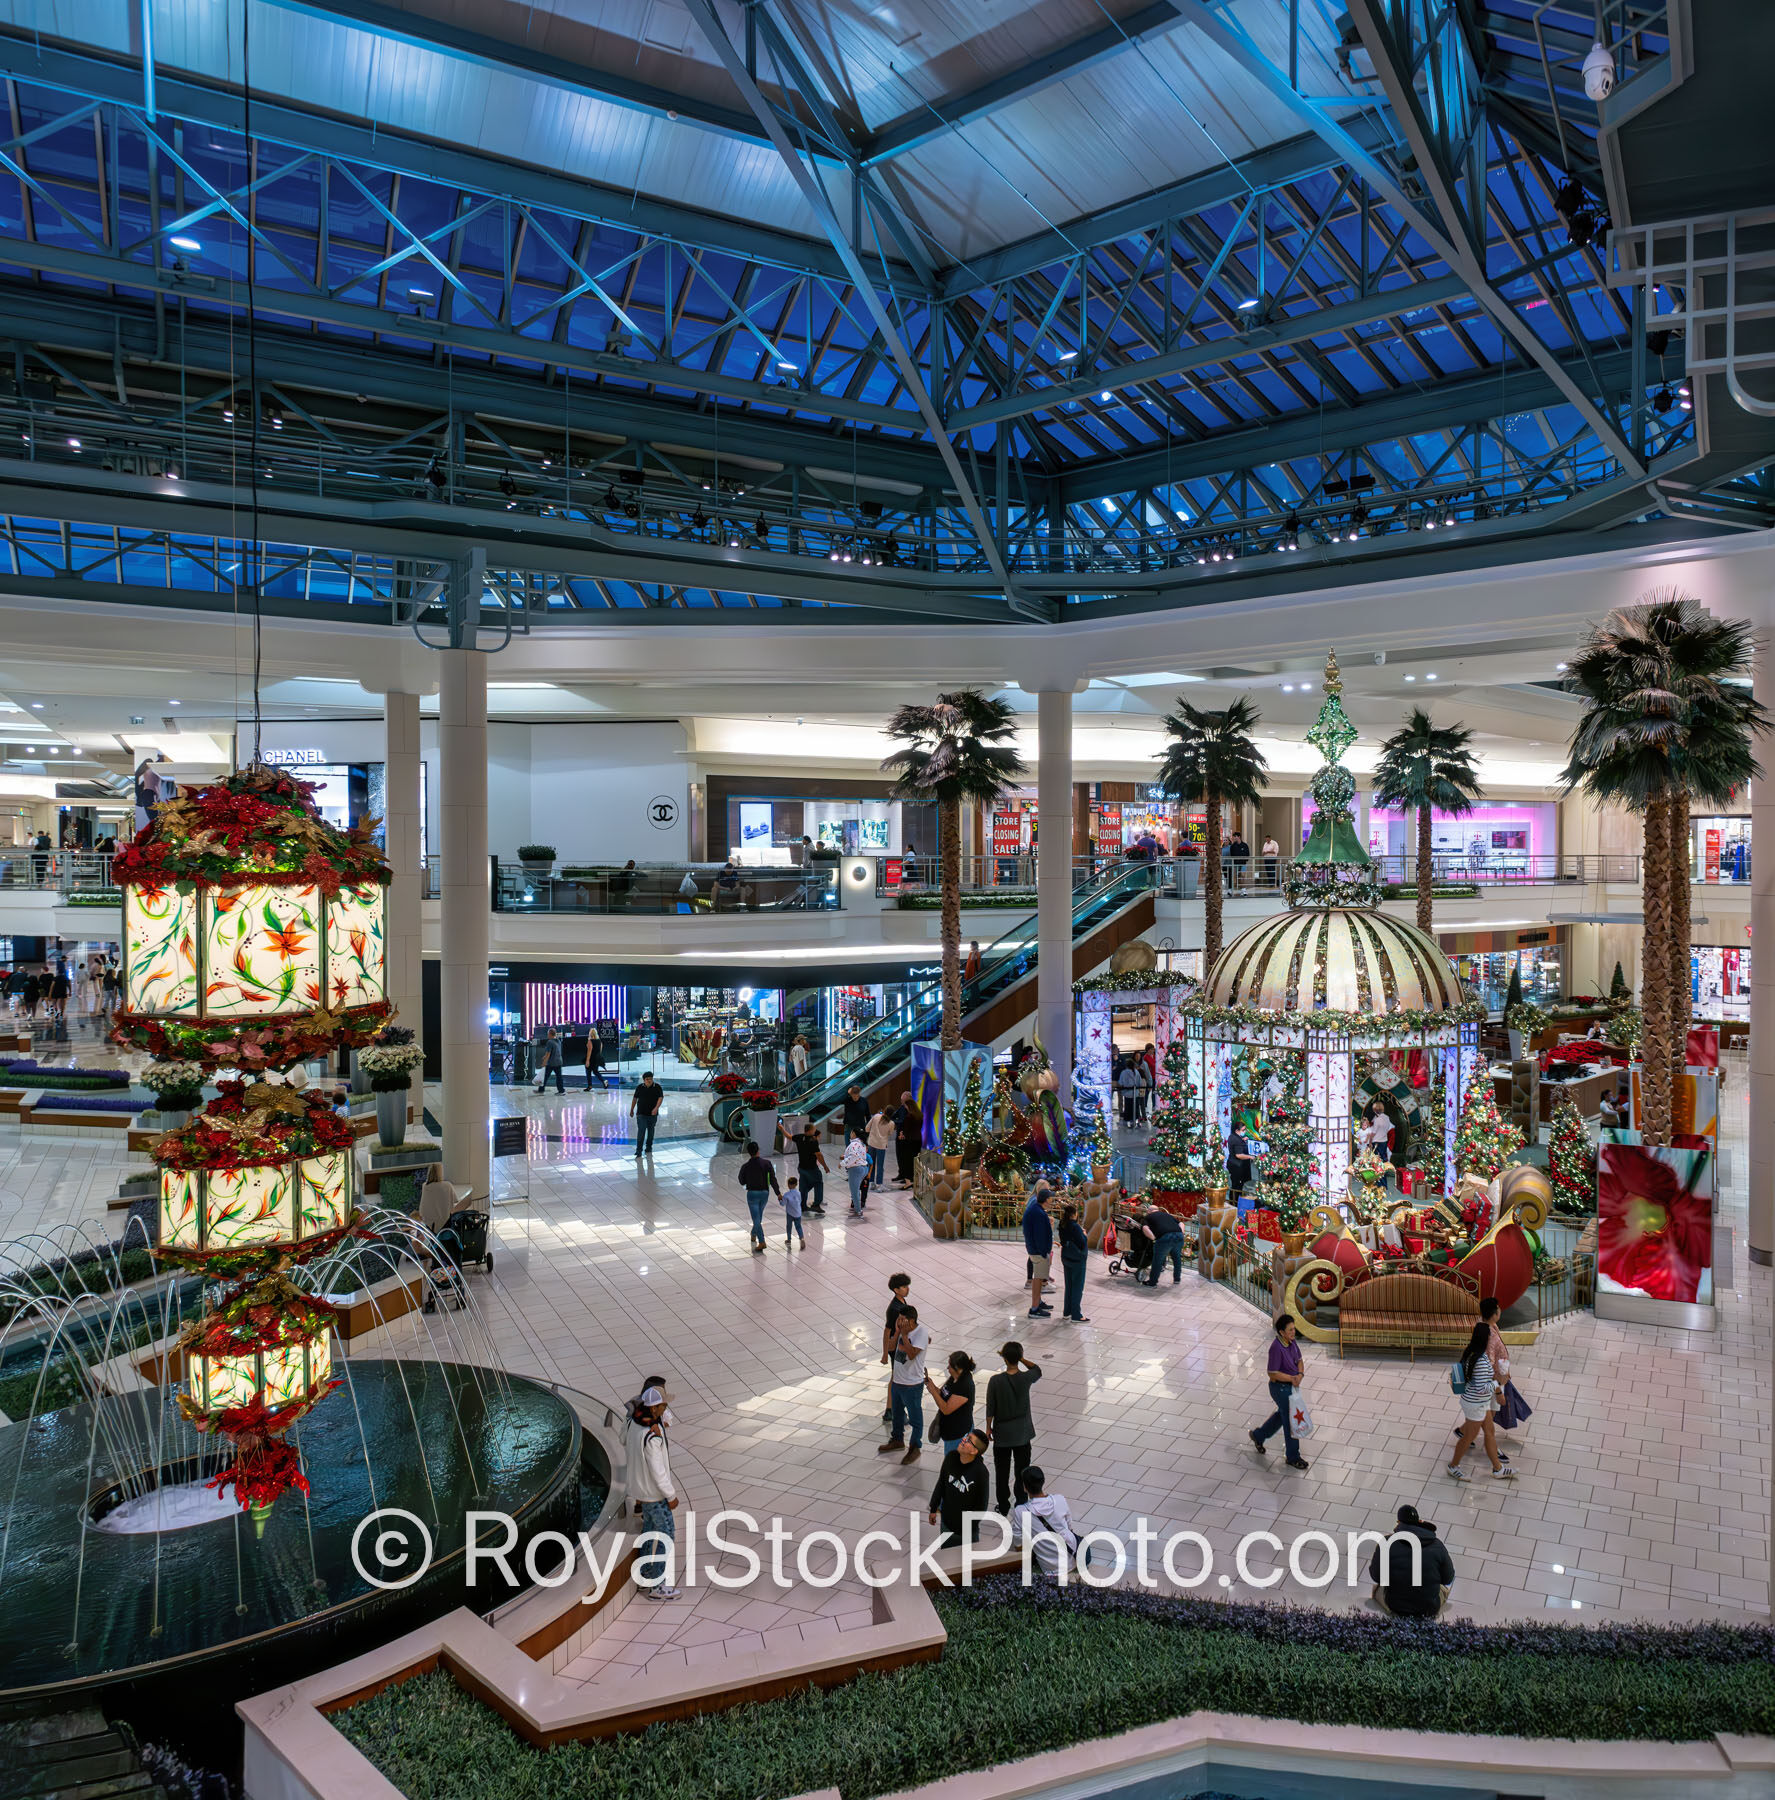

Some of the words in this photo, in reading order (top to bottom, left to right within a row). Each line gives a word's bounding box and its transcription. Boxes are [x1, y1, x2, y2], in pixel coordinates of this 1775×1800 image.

[264, 751, 324, 763] CHANEL
[994, 817, 1019, 826] STORE
[1100, 817, 1120, 825] STORE
[994, 829, 1019, 840] CLOSING
[1099, 829, 1121, 840] CLOSING
[994, 844, 1019, 854] SALE!
[1100, 844, 1120, 854] SALE!
